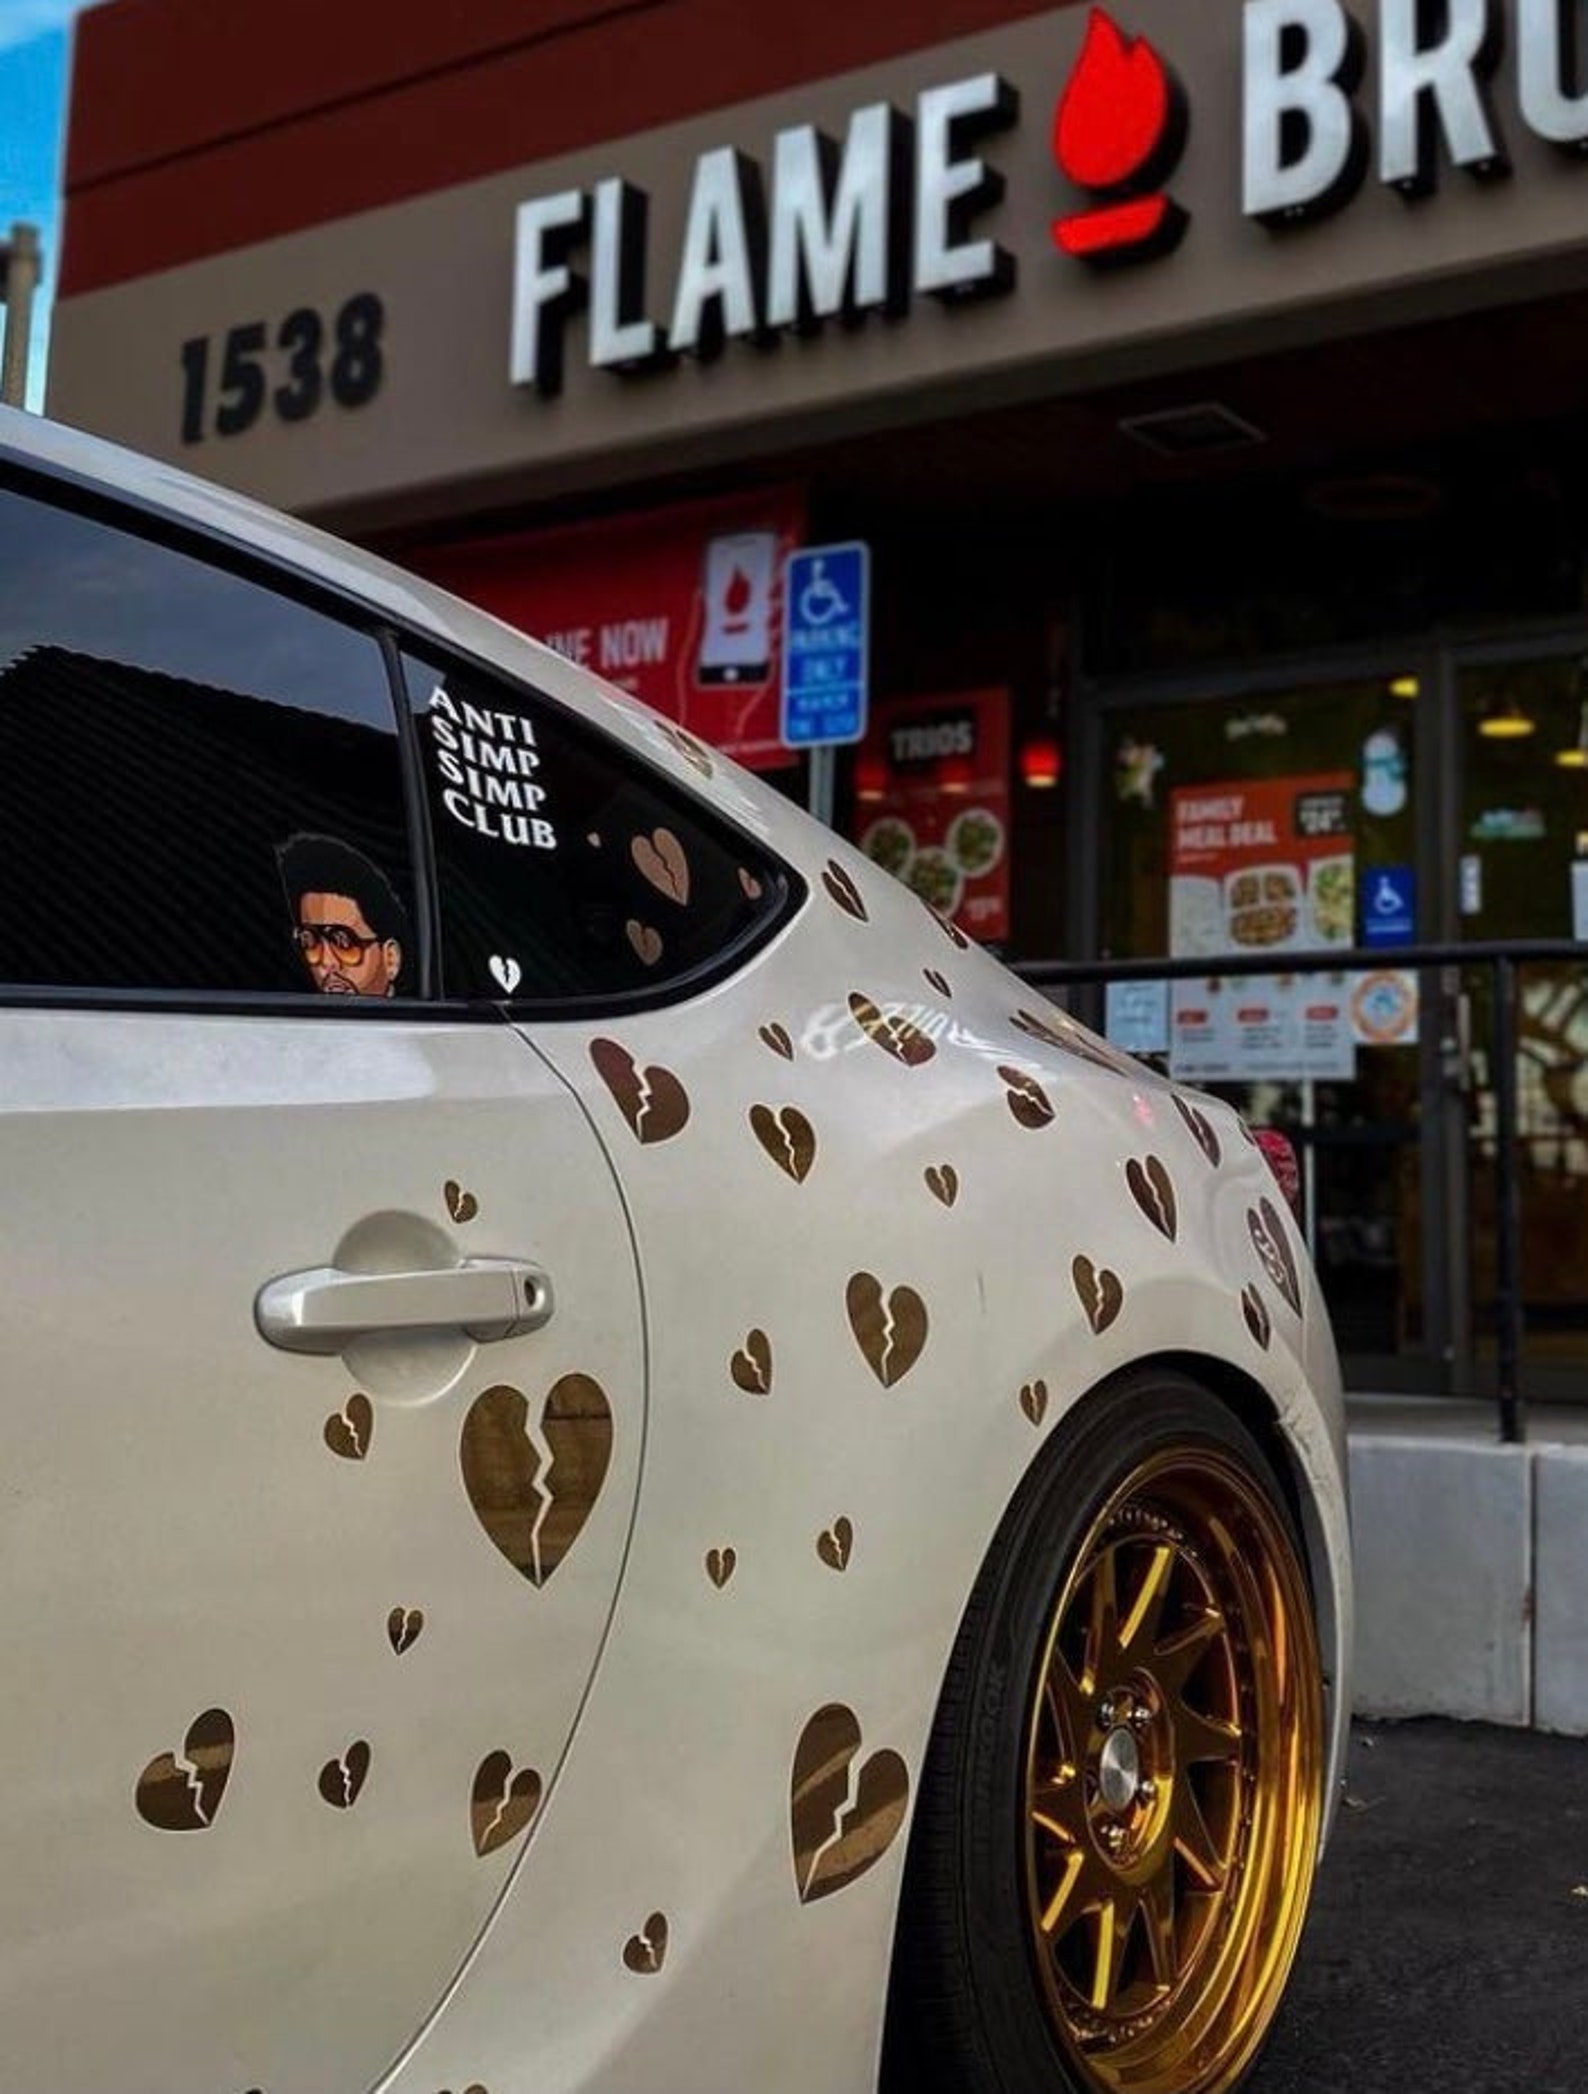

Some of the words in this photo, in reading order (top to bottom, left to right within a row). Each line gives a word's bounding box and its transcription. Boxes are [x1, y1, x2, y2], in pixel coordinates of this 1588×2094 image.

[510, 73, 998, 386] FLAME
[180, 290, 386, 446] 1538
[600, 616, 669, 669] NOW
[429, 686, 537, 747] ANTI
[431, 715, 540, 777] SIMP
[891, 721, 972, 761] TRIOS
[438, 750, 547, 811] SIMP
[443, 788, 557, 850] CLUB
[1178, 823, 1224, 849] MEAL
[1227, 819, 1277, 846] DEAL
